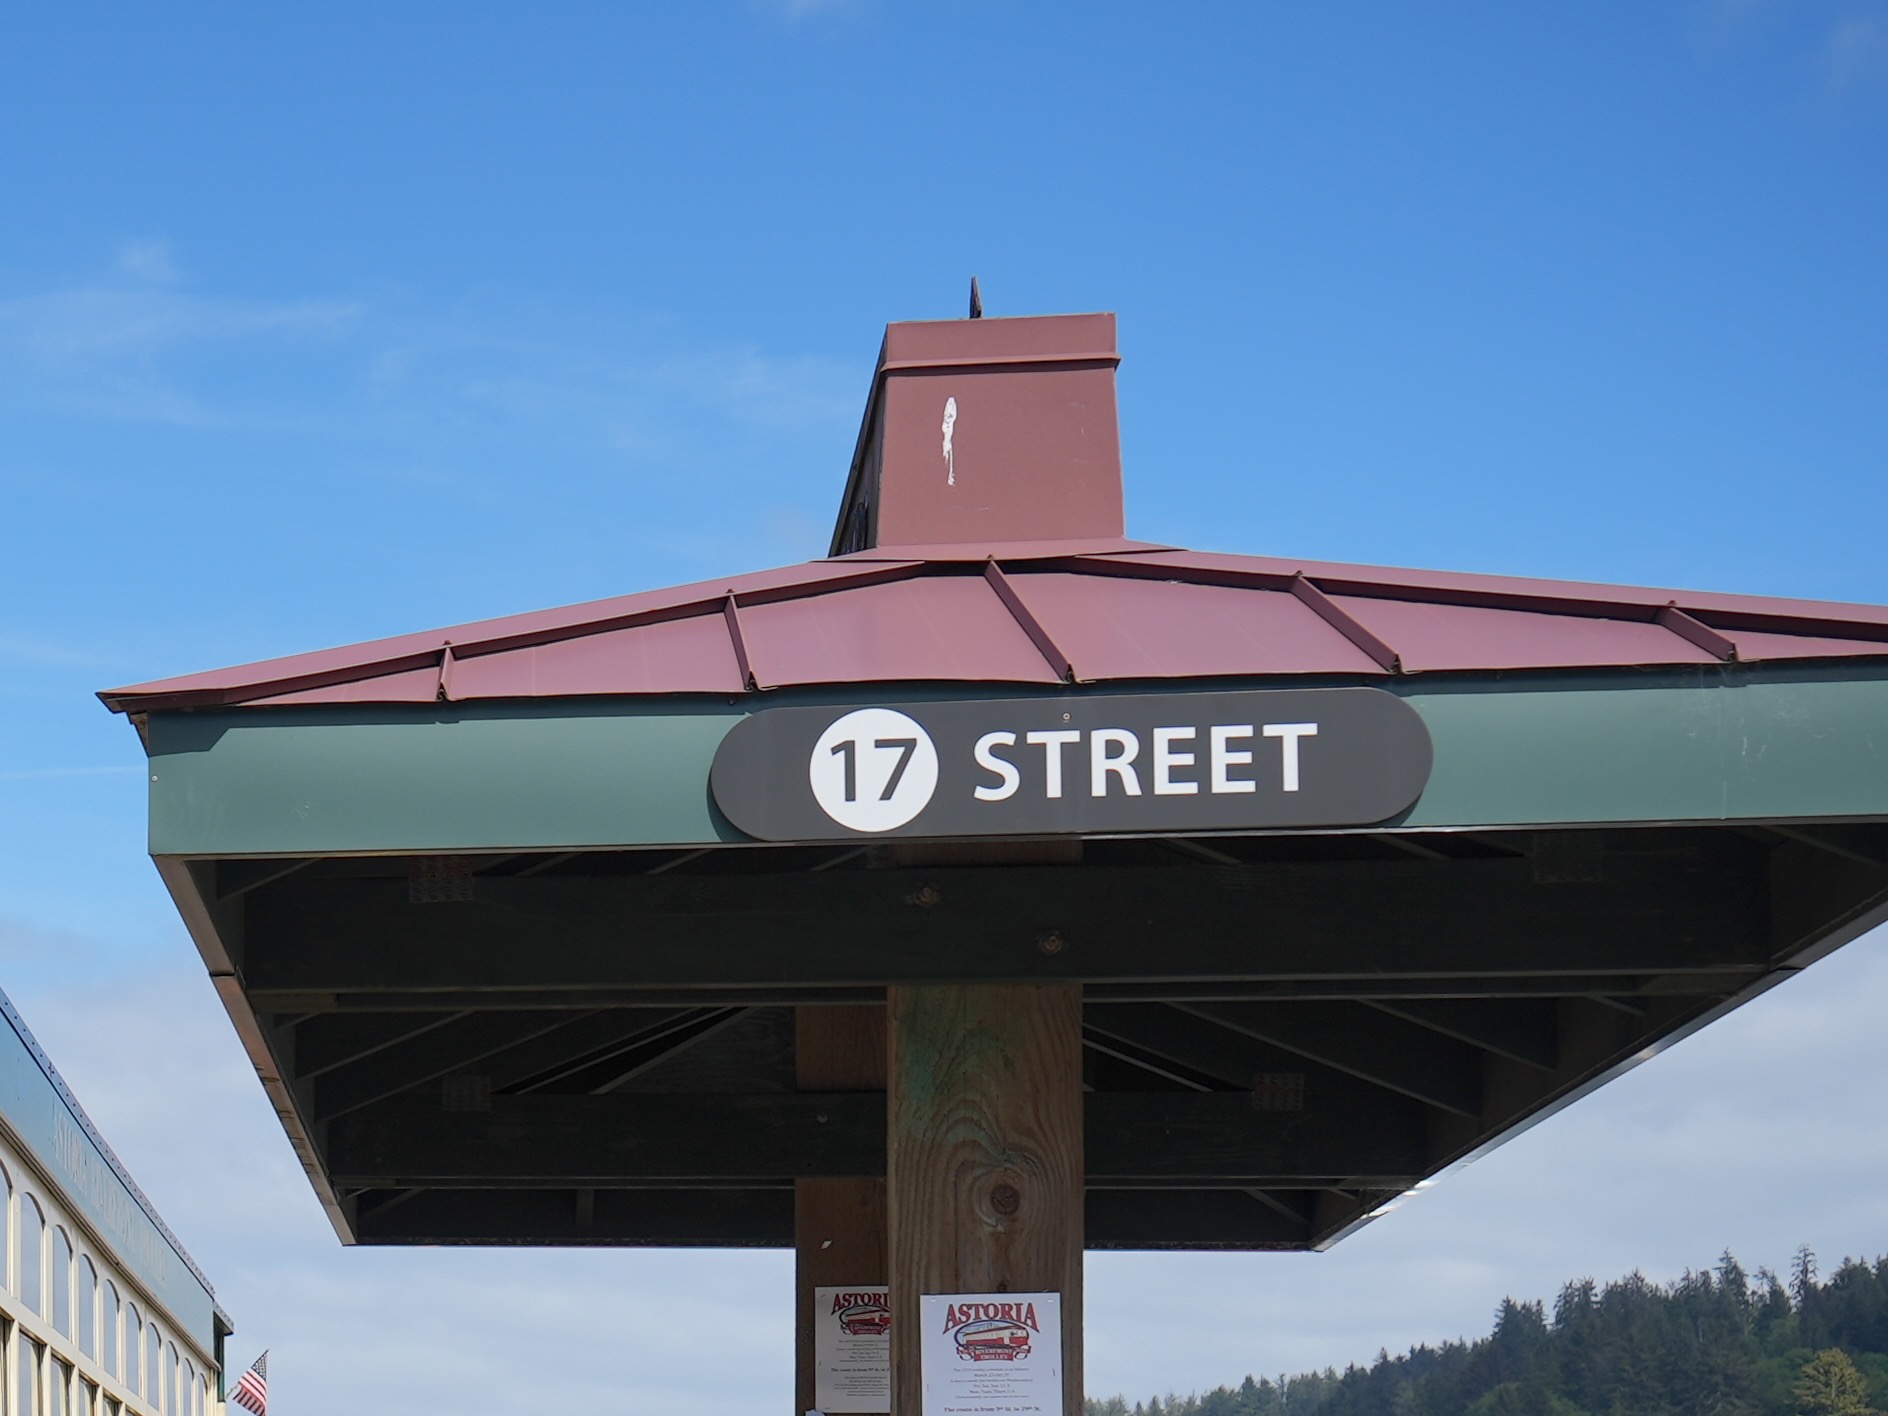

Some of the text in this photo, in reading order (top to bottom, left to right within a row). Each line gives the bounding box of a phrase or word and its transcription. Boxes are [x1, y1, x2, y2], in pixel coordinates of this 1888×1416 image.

[830, 723, 1319, 802] 17 STREET
[830, 1292, 890, 1317] ASTORI
[942, 1302, 1040, 1335] ASTORIA
